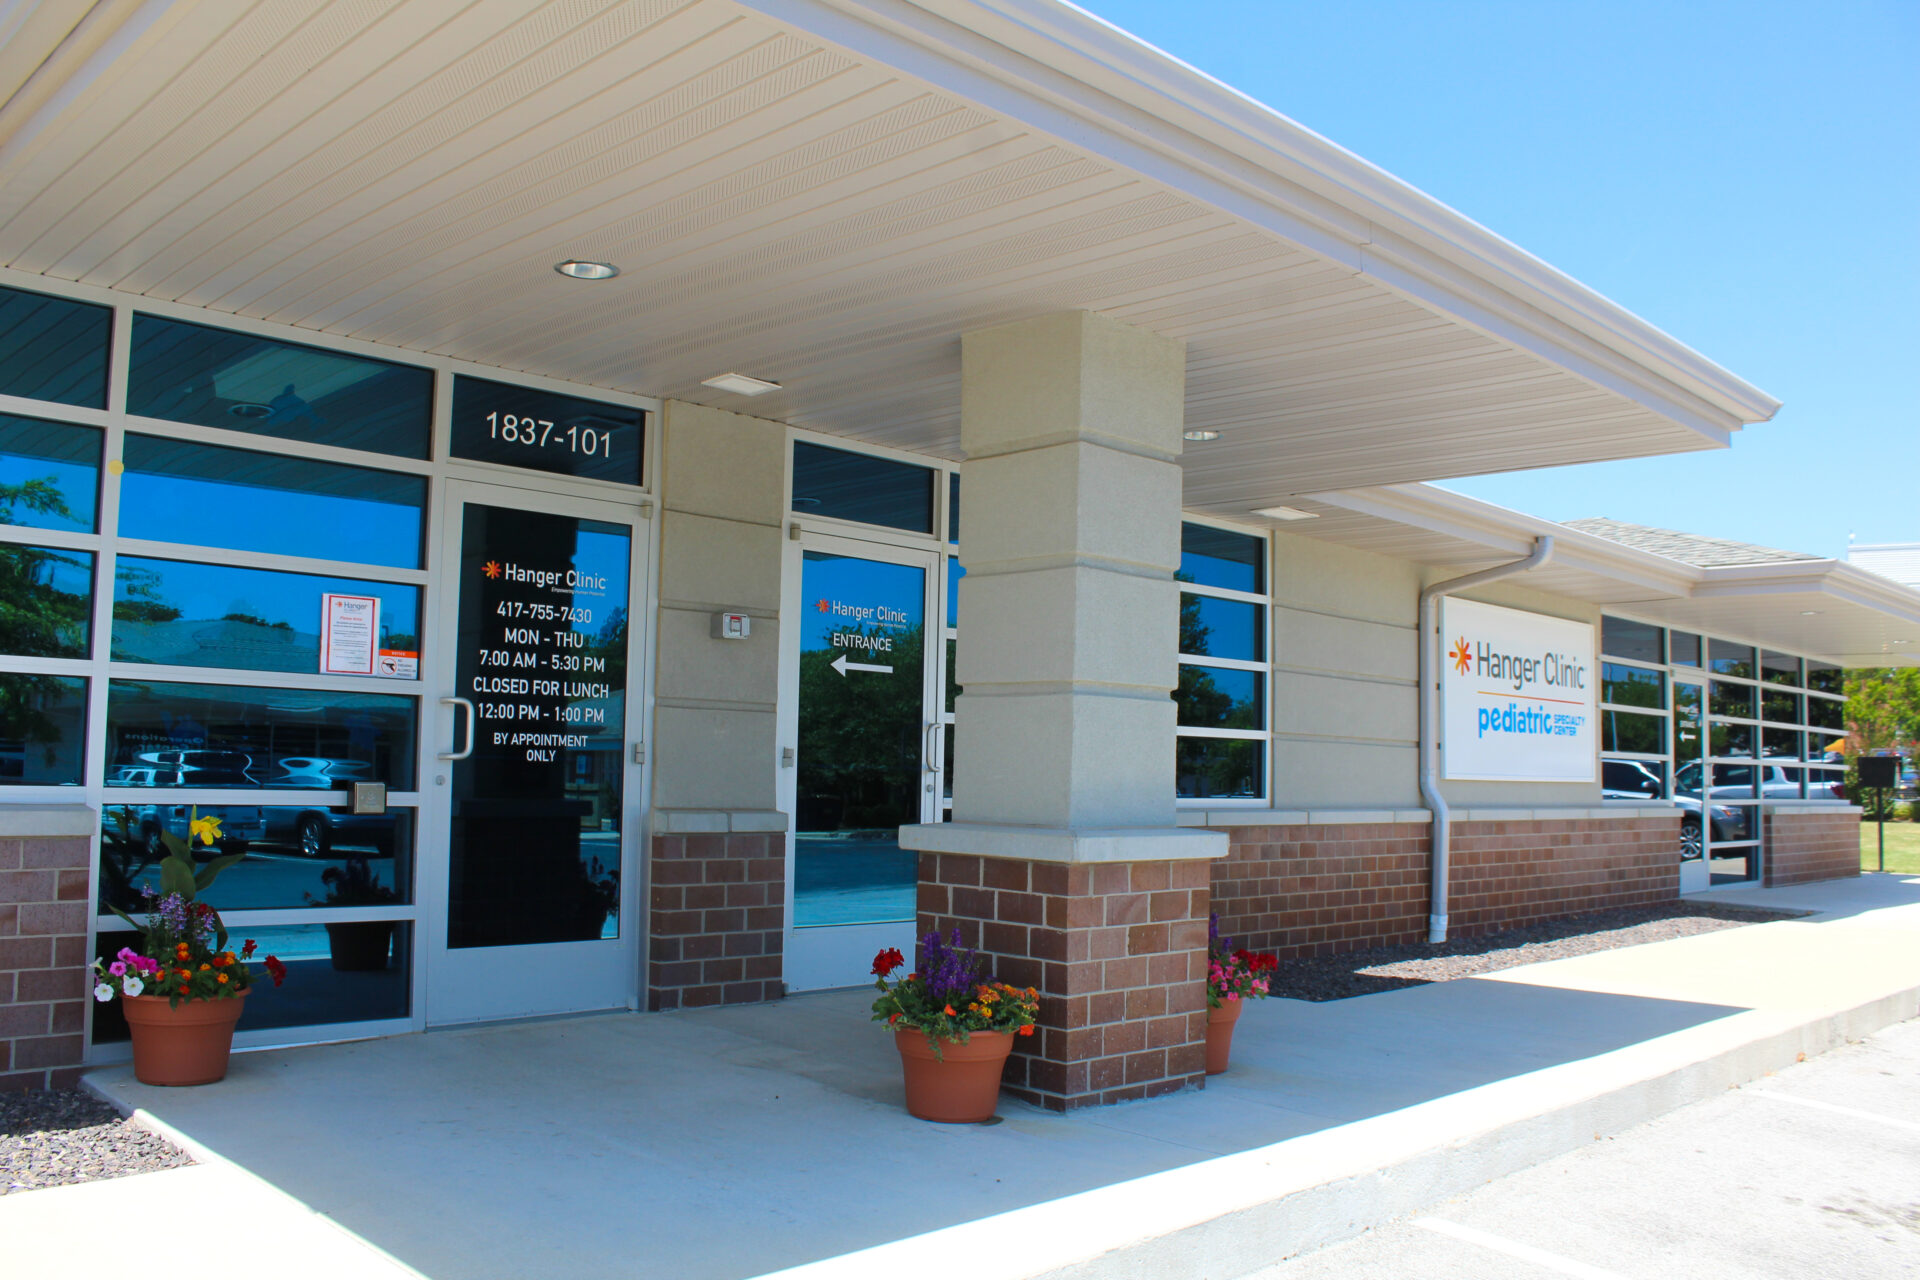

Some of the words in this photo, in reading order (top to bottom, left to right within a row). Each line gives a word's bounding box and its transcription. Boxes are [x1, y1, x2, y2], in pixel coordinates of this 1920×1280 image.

[486, 411, 611, 458] 1837-101
[505, 562, 562, 588] Hanger
[566, 569, 606, 590] Clinic
[497, 601, 592, 623] 417-755-7430
[832, 600, 874, 621] Hanger
[877, 606, 907, 623] Clinic
[504, 627, 539, 645] MON
[554, 631, 584, 648] THU
[833, 632, 892, 652] ENTRANCE
[479, 649, 509, 667] 7:00
[513, 652, 536, 668] AM
[551, 654, 580, 671] 5:30
[583, 657, 605, 673] PM
[1477, 641, 1541, 690] Hanger
[1544, 652, 1585, 689] Clinic
[473, 676, 529, 695] CLOSED
[533, 680, 560, 696] FOR
[563, 682, 610, 698] LUNCH
[478, 702, 515, 719] 12:00
[518, 704, 540, 721] PM
[554, 706, 580, 722] 1:00
[584, 708, 605, 723] PM
[1478, 703, 1553, 738] pediatric
[1553, 714, 1586, 727] SPECIALTY
[493, 732, 508, 745] BY
[511, 733, 588, 747] APPOINTMENT
[1553, 725, 1577, 737] CENTER
[526, 749, 557, 762] ONLY
